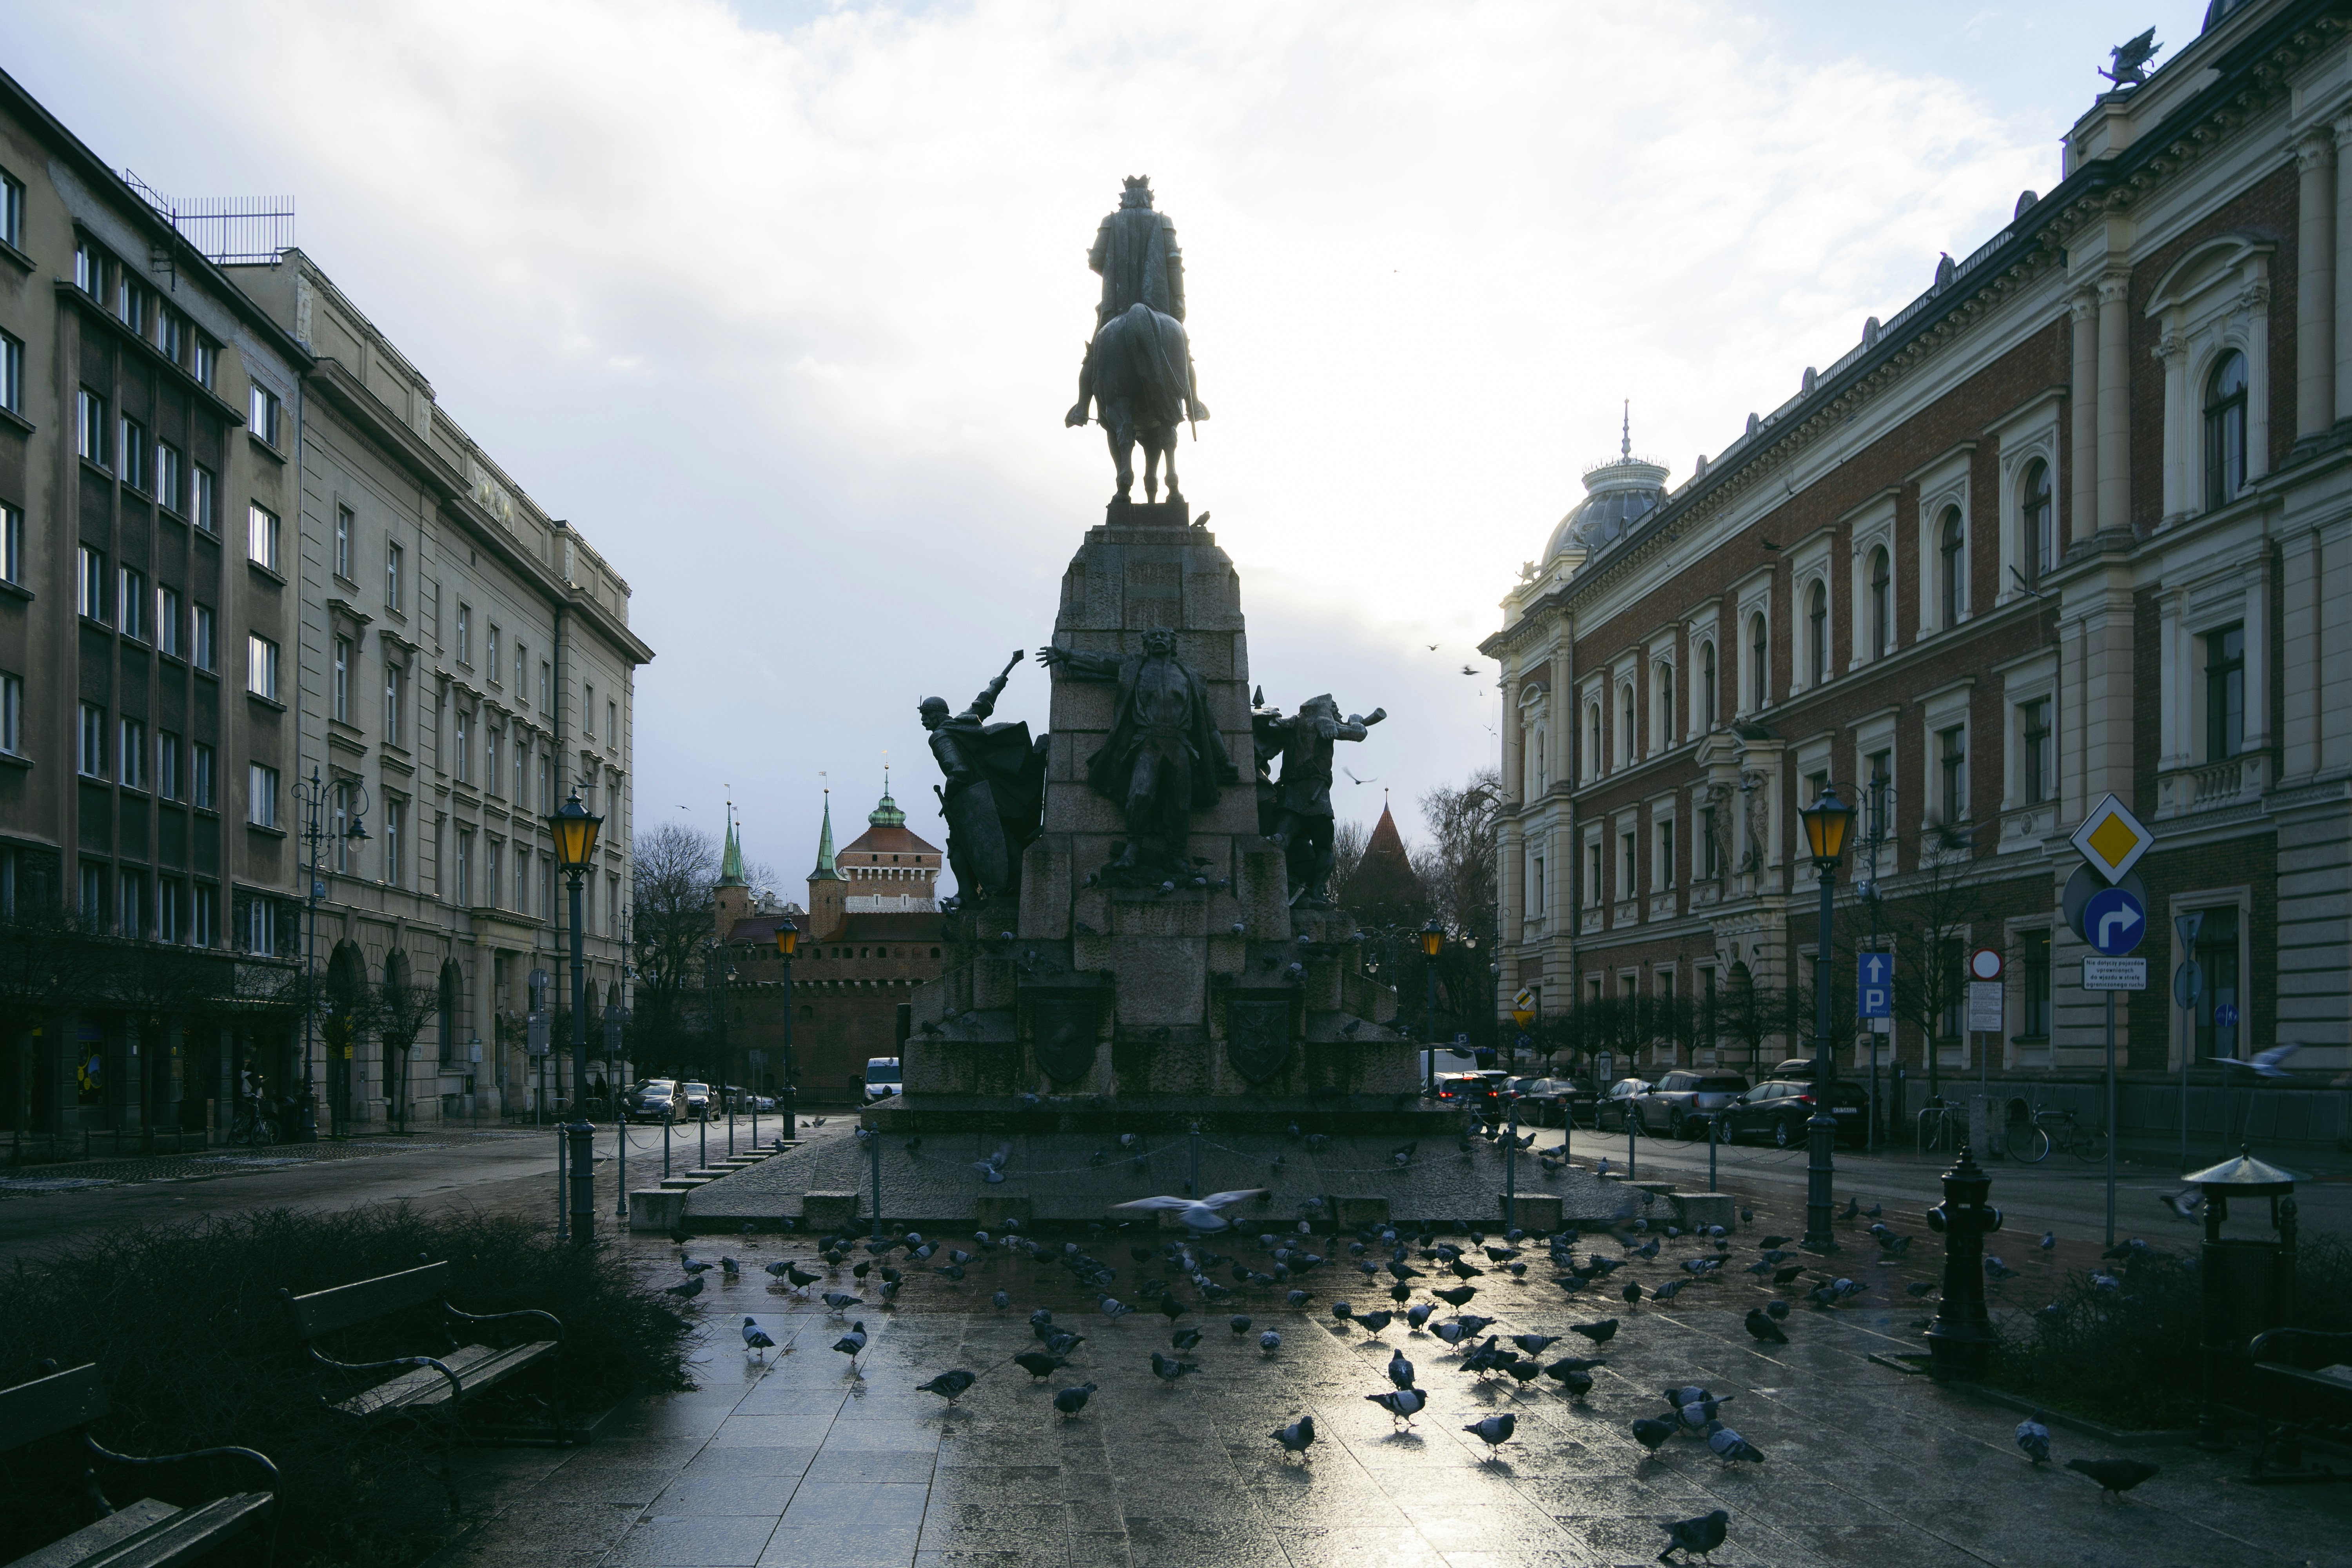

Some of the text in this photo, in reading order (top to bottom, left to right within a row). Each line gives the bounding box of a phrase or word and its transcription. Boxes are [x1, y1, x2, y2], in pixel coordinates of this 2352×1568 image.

[1866, 989, 1884, 1013] P
[1458, 1034, 1467, 1044] P
[1900, 1070, 1905, 1078] P
